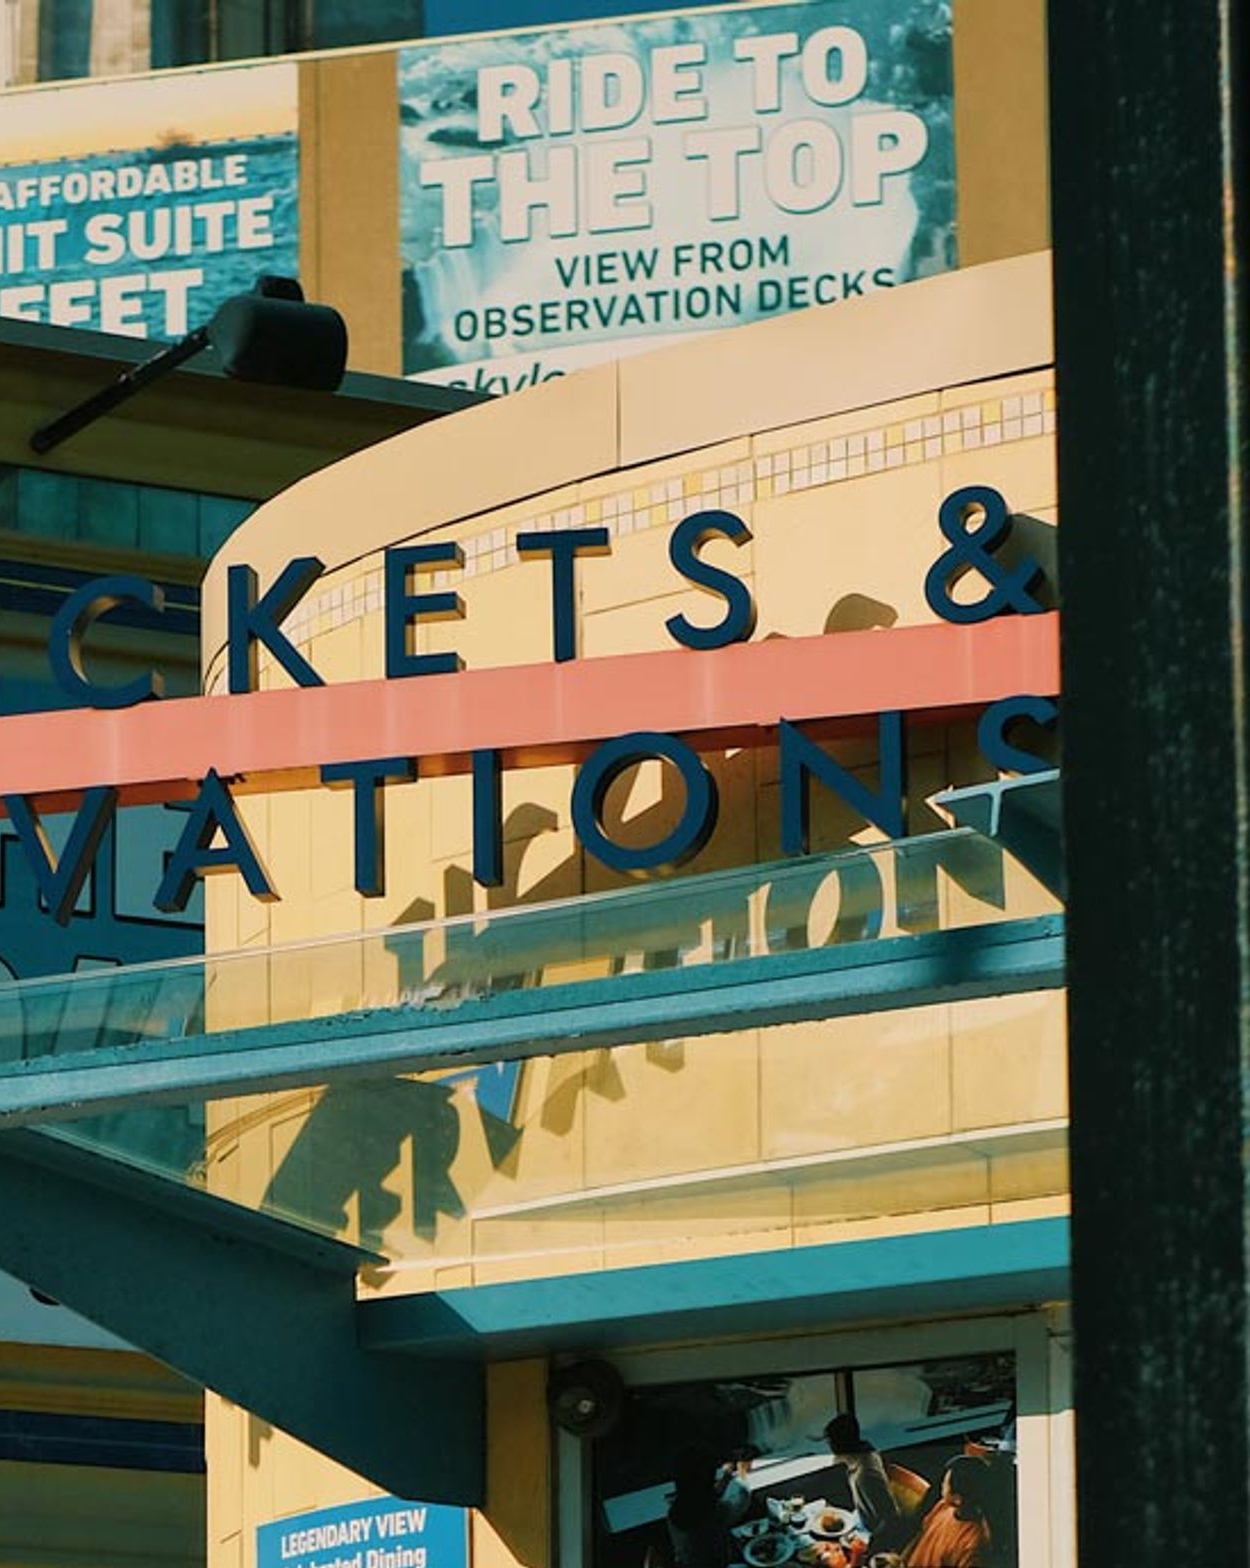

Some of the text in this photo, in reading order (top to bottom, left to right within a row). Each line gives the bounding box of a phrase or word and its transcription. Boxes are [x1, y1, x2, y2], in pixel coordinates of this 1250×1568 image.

[477, 26, 868, 143] RIDE TO
[421, 110, 929, 249] THE TOP
[85, 197, 275, 264] SUITE
[555, 235, 790, 288] VIEW FROM
[454, 267, 896, 342] OBSERVATION DECKS
[924, 485, 1053, 625] &
[281, 1508, 427, 1560] LEGENDARY VIEW
